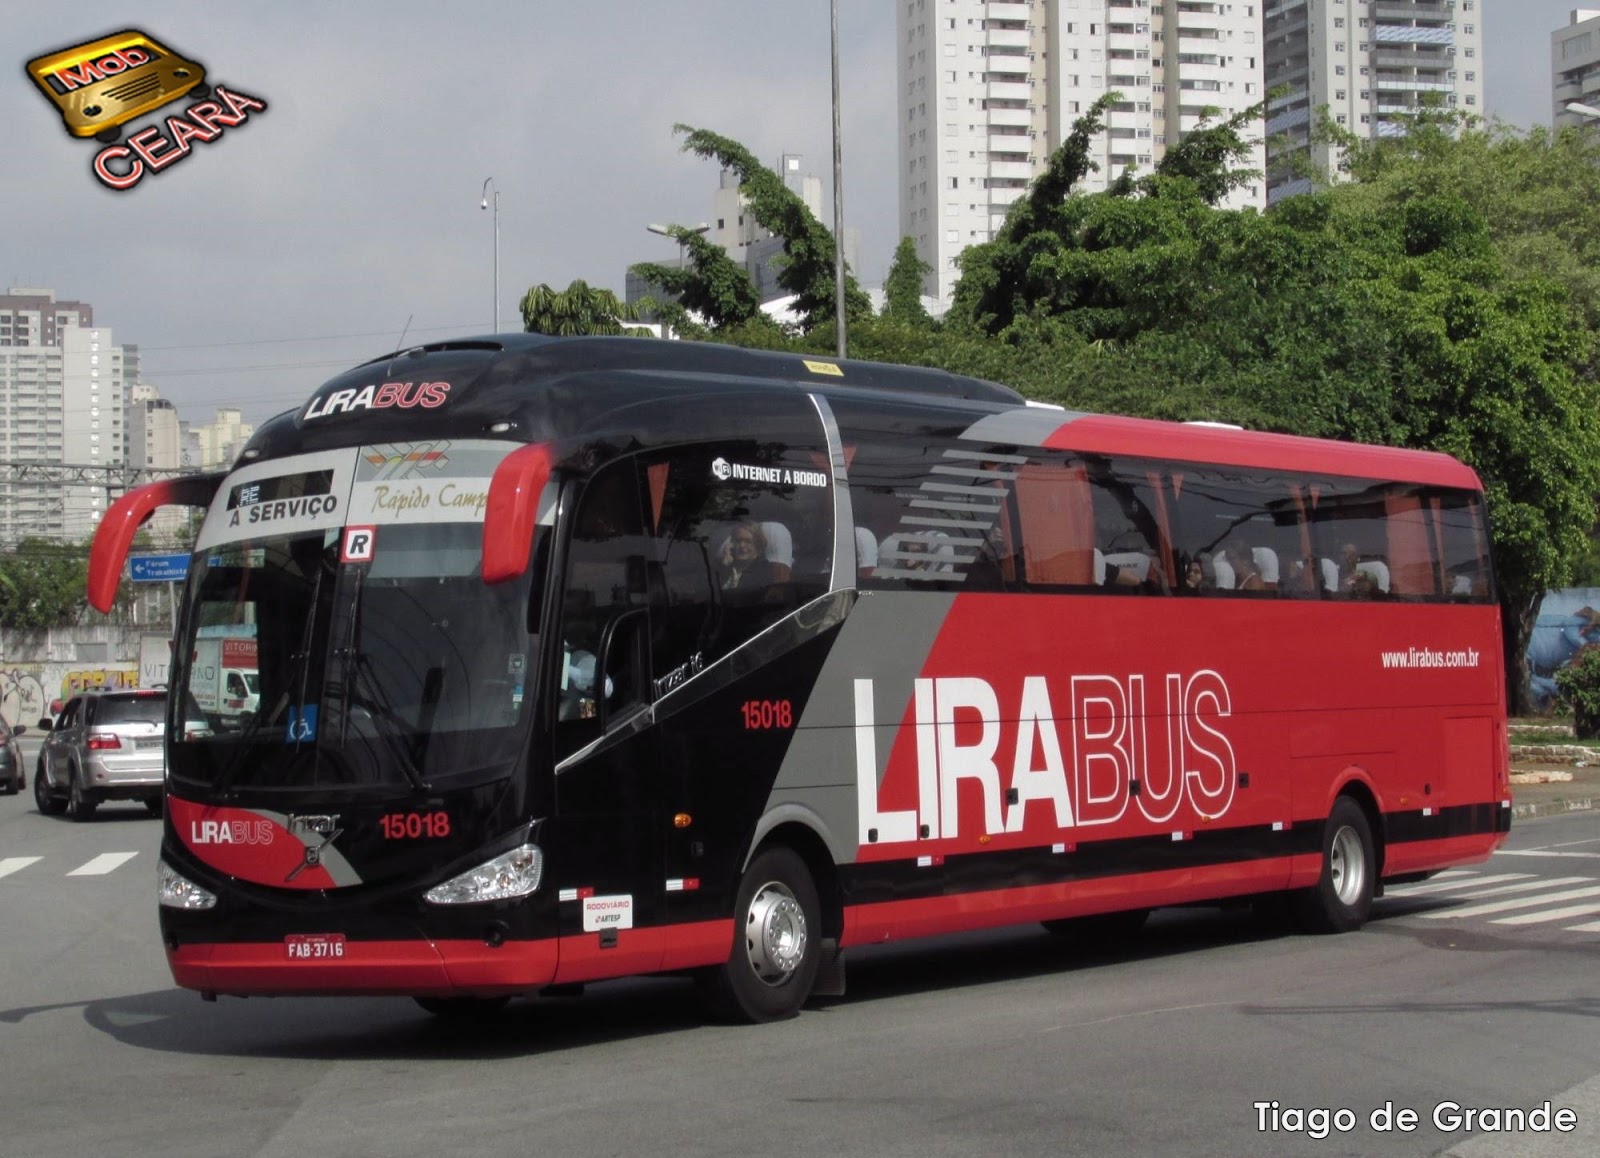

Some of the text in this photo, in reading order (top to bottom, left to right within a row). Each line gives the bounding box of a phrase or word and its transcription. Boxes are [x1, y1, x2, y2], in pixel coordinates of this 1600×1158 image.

[303, 381, 451, 421] LIRABUS
[732, 463, 782, 483] INTERNET
[783, 470, 792, 484] A
[793, 471, 827, 487] BORDO
[248, 495, 338, 524] SERVIÇO
[370, 485, 431, 519] Rápido
[349, 534, 369, 555] R
[1381, 646, 1479, 668] www.lirabus.com.br
[741, 699, 793, 729] 15018
[853, 668, 1237, 846] LIRABUS
[191, 820, 274, 846] LIRABUS
[379, 811, 451, 840] 15018
